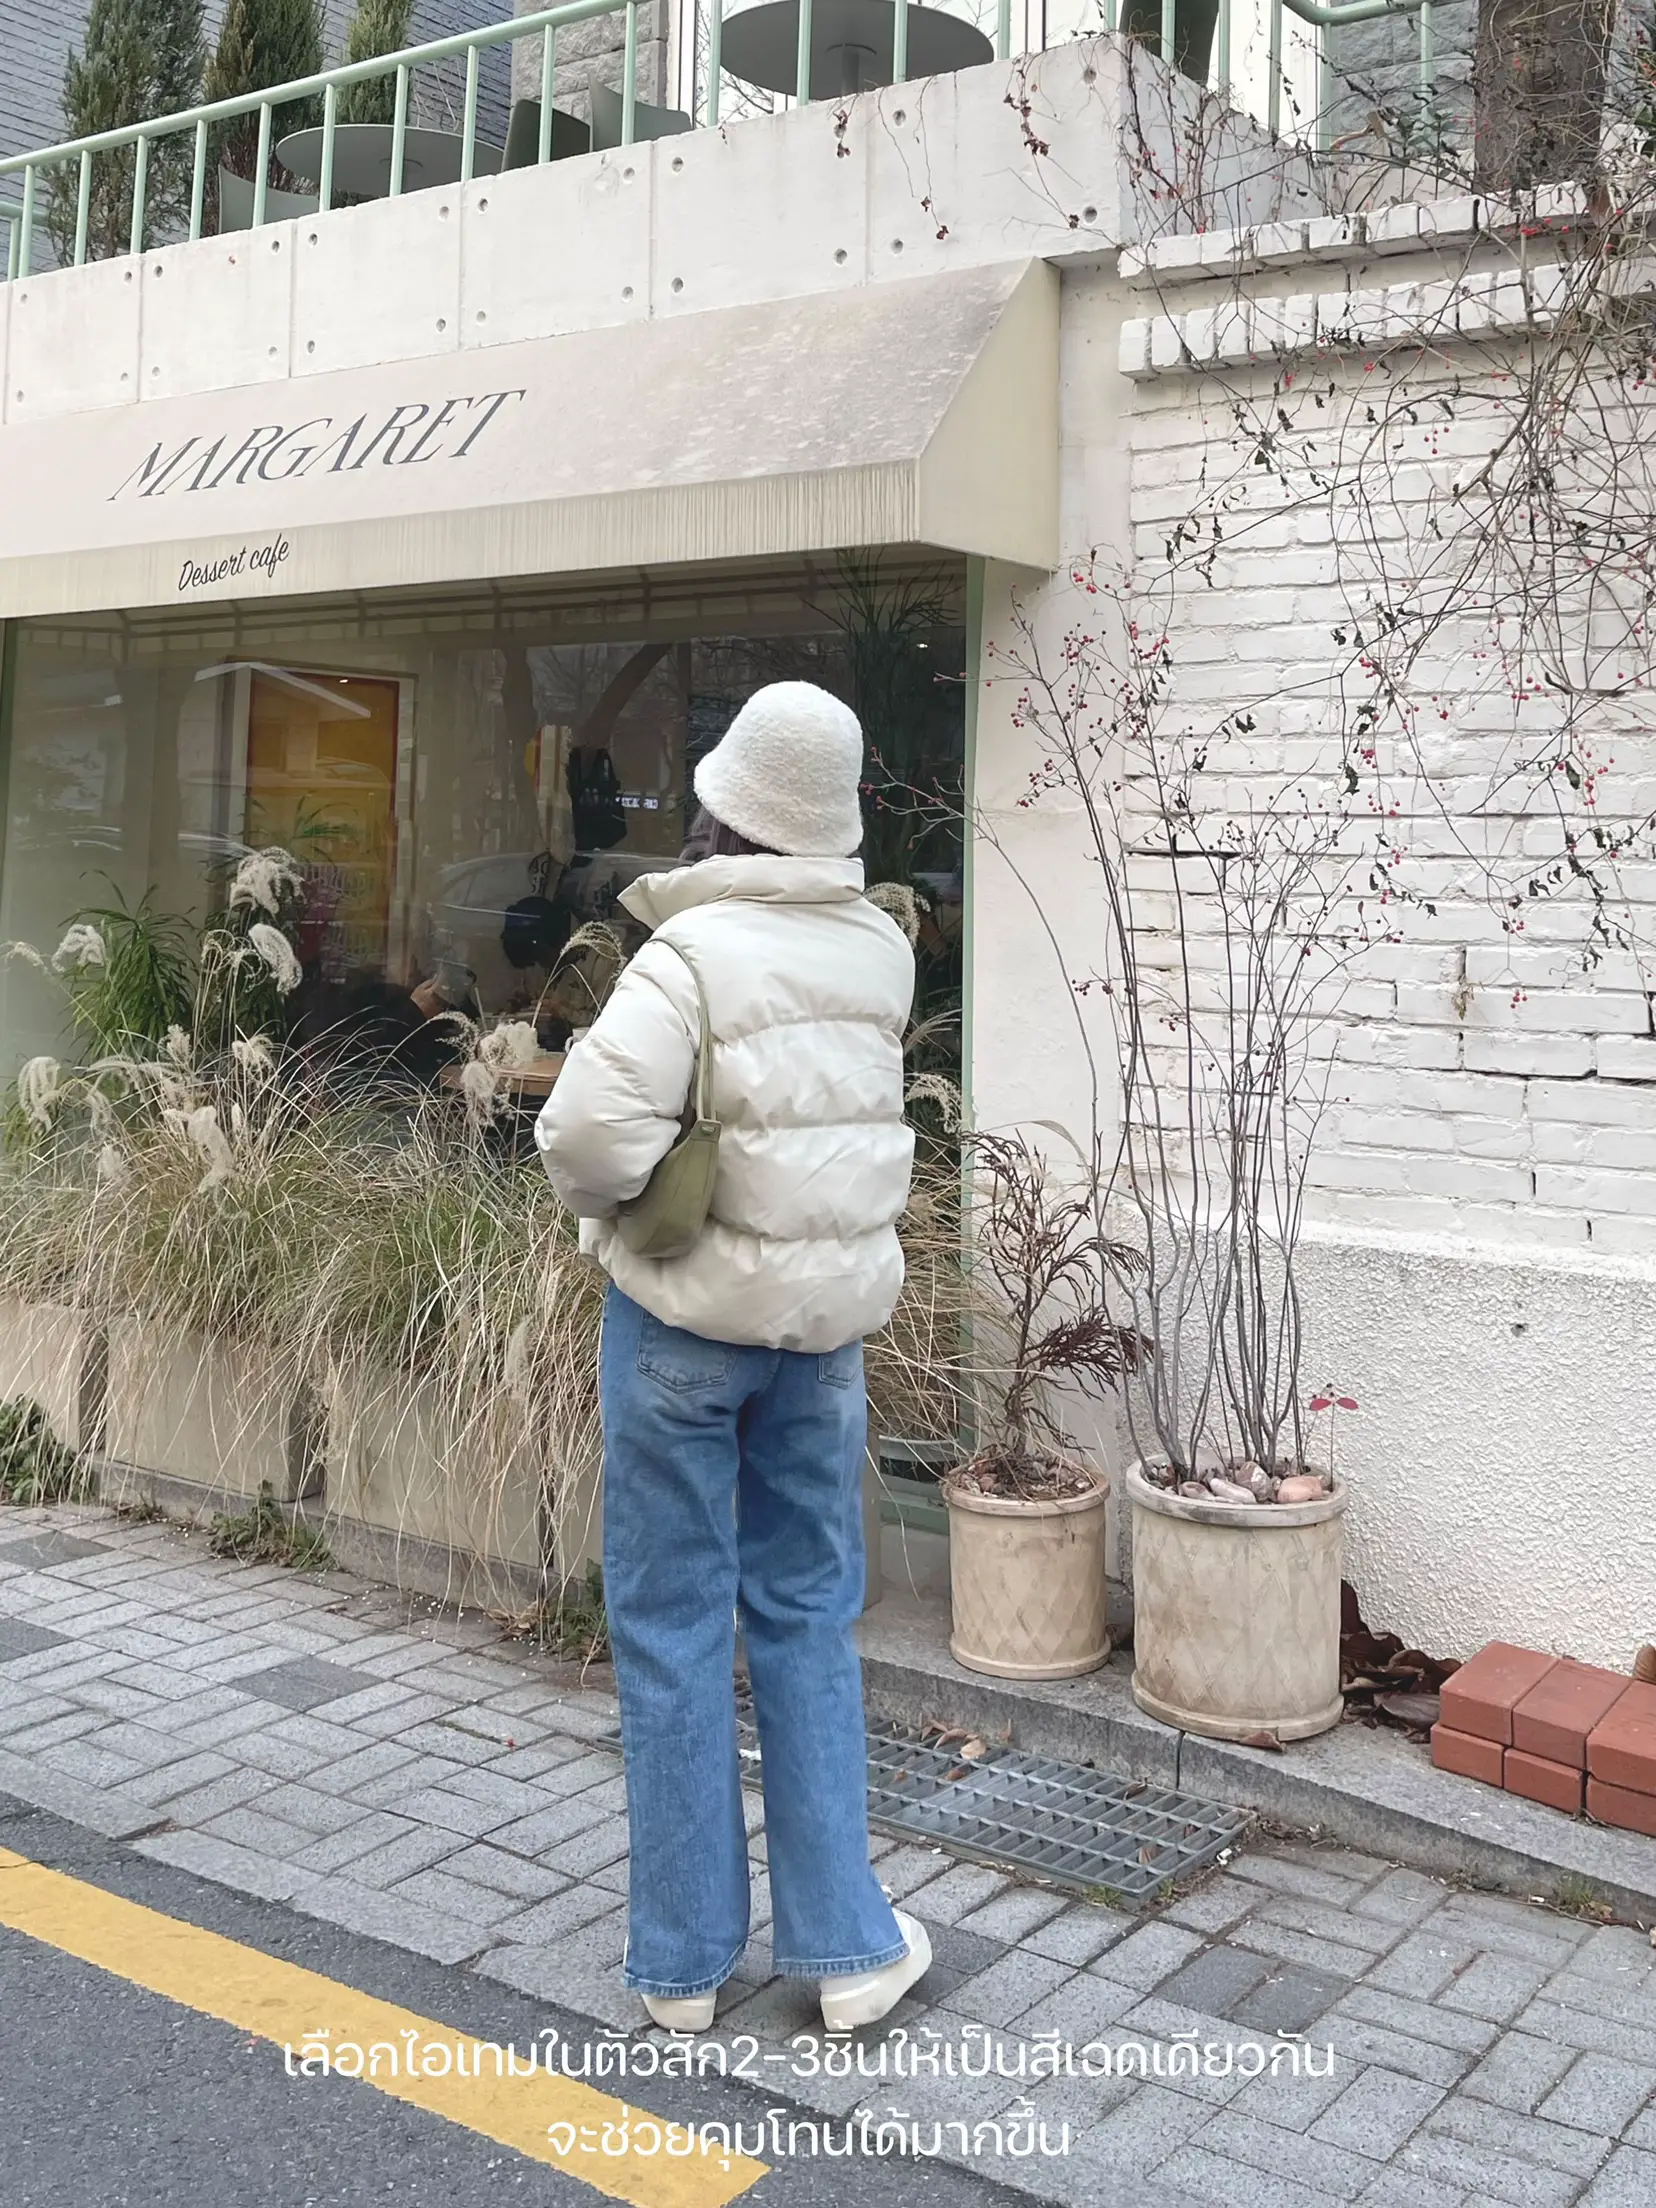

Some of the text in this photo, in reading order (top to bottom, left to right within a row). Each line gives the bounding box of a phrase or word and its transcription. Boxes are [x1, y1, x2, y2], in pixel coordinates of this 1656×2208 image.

[106, 388, 527, 502] MARGARET
[177, 532, 291, 592] Dessert cafe
